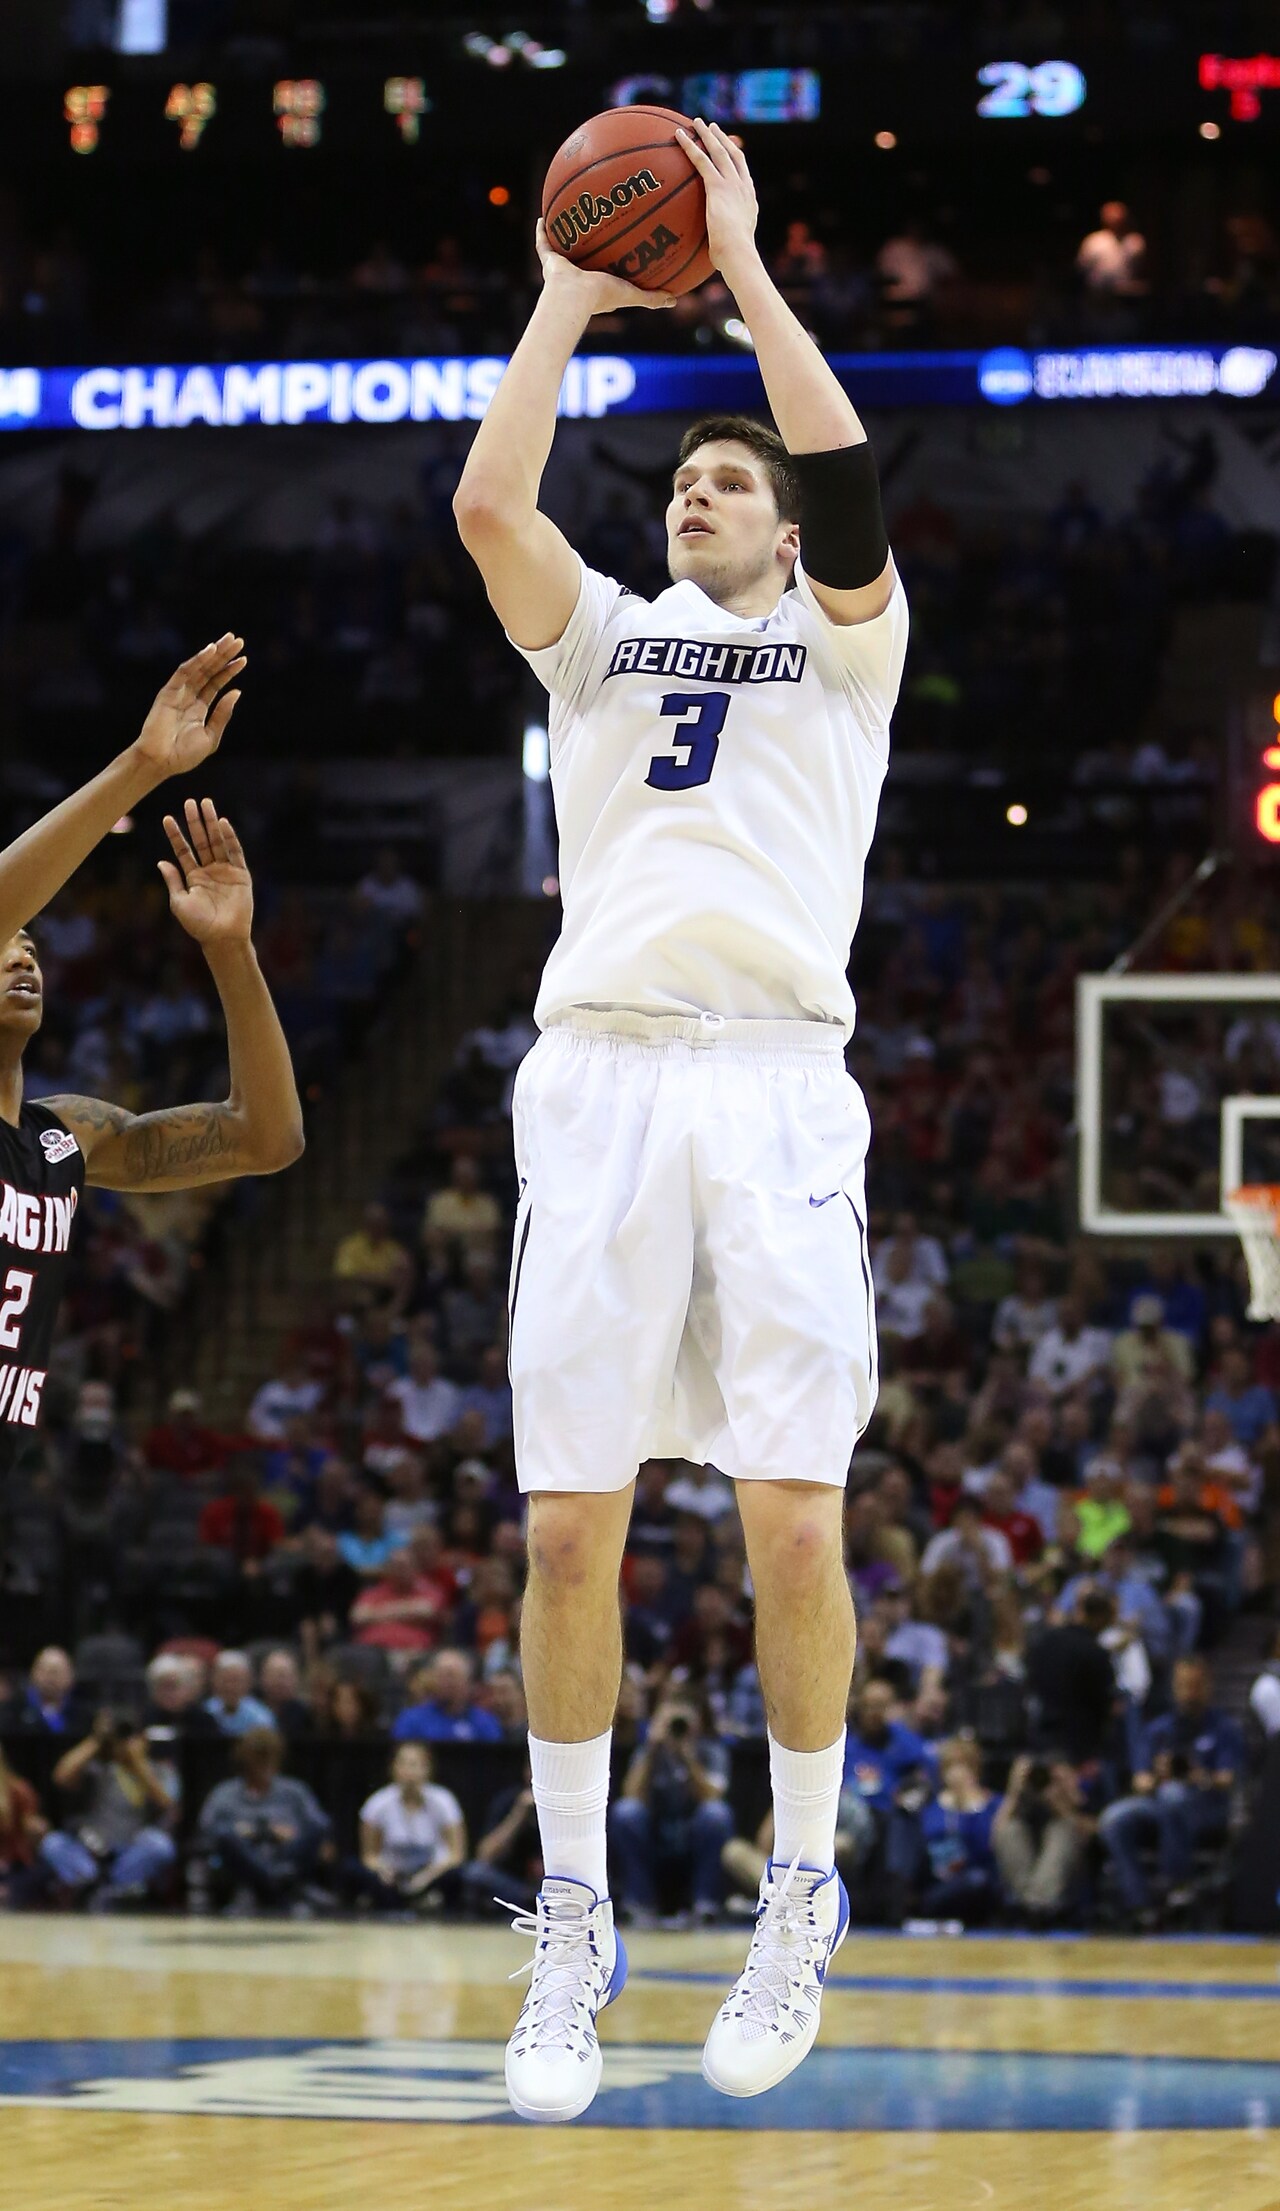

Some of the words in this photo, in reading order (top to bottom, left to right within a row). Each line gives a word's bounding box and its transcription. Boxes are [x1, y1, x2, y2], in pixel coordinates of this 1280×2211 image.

[977, 60, 1086, 118] 29
[550, 168, 661, 252] Wilson
[71, 356, 636, 430] CHAMPIONSIP
[604, 640, 805, 682] REIGHTON
[644, 691, 732, 791] 3
[0, 1269, 33, 1349] 2
